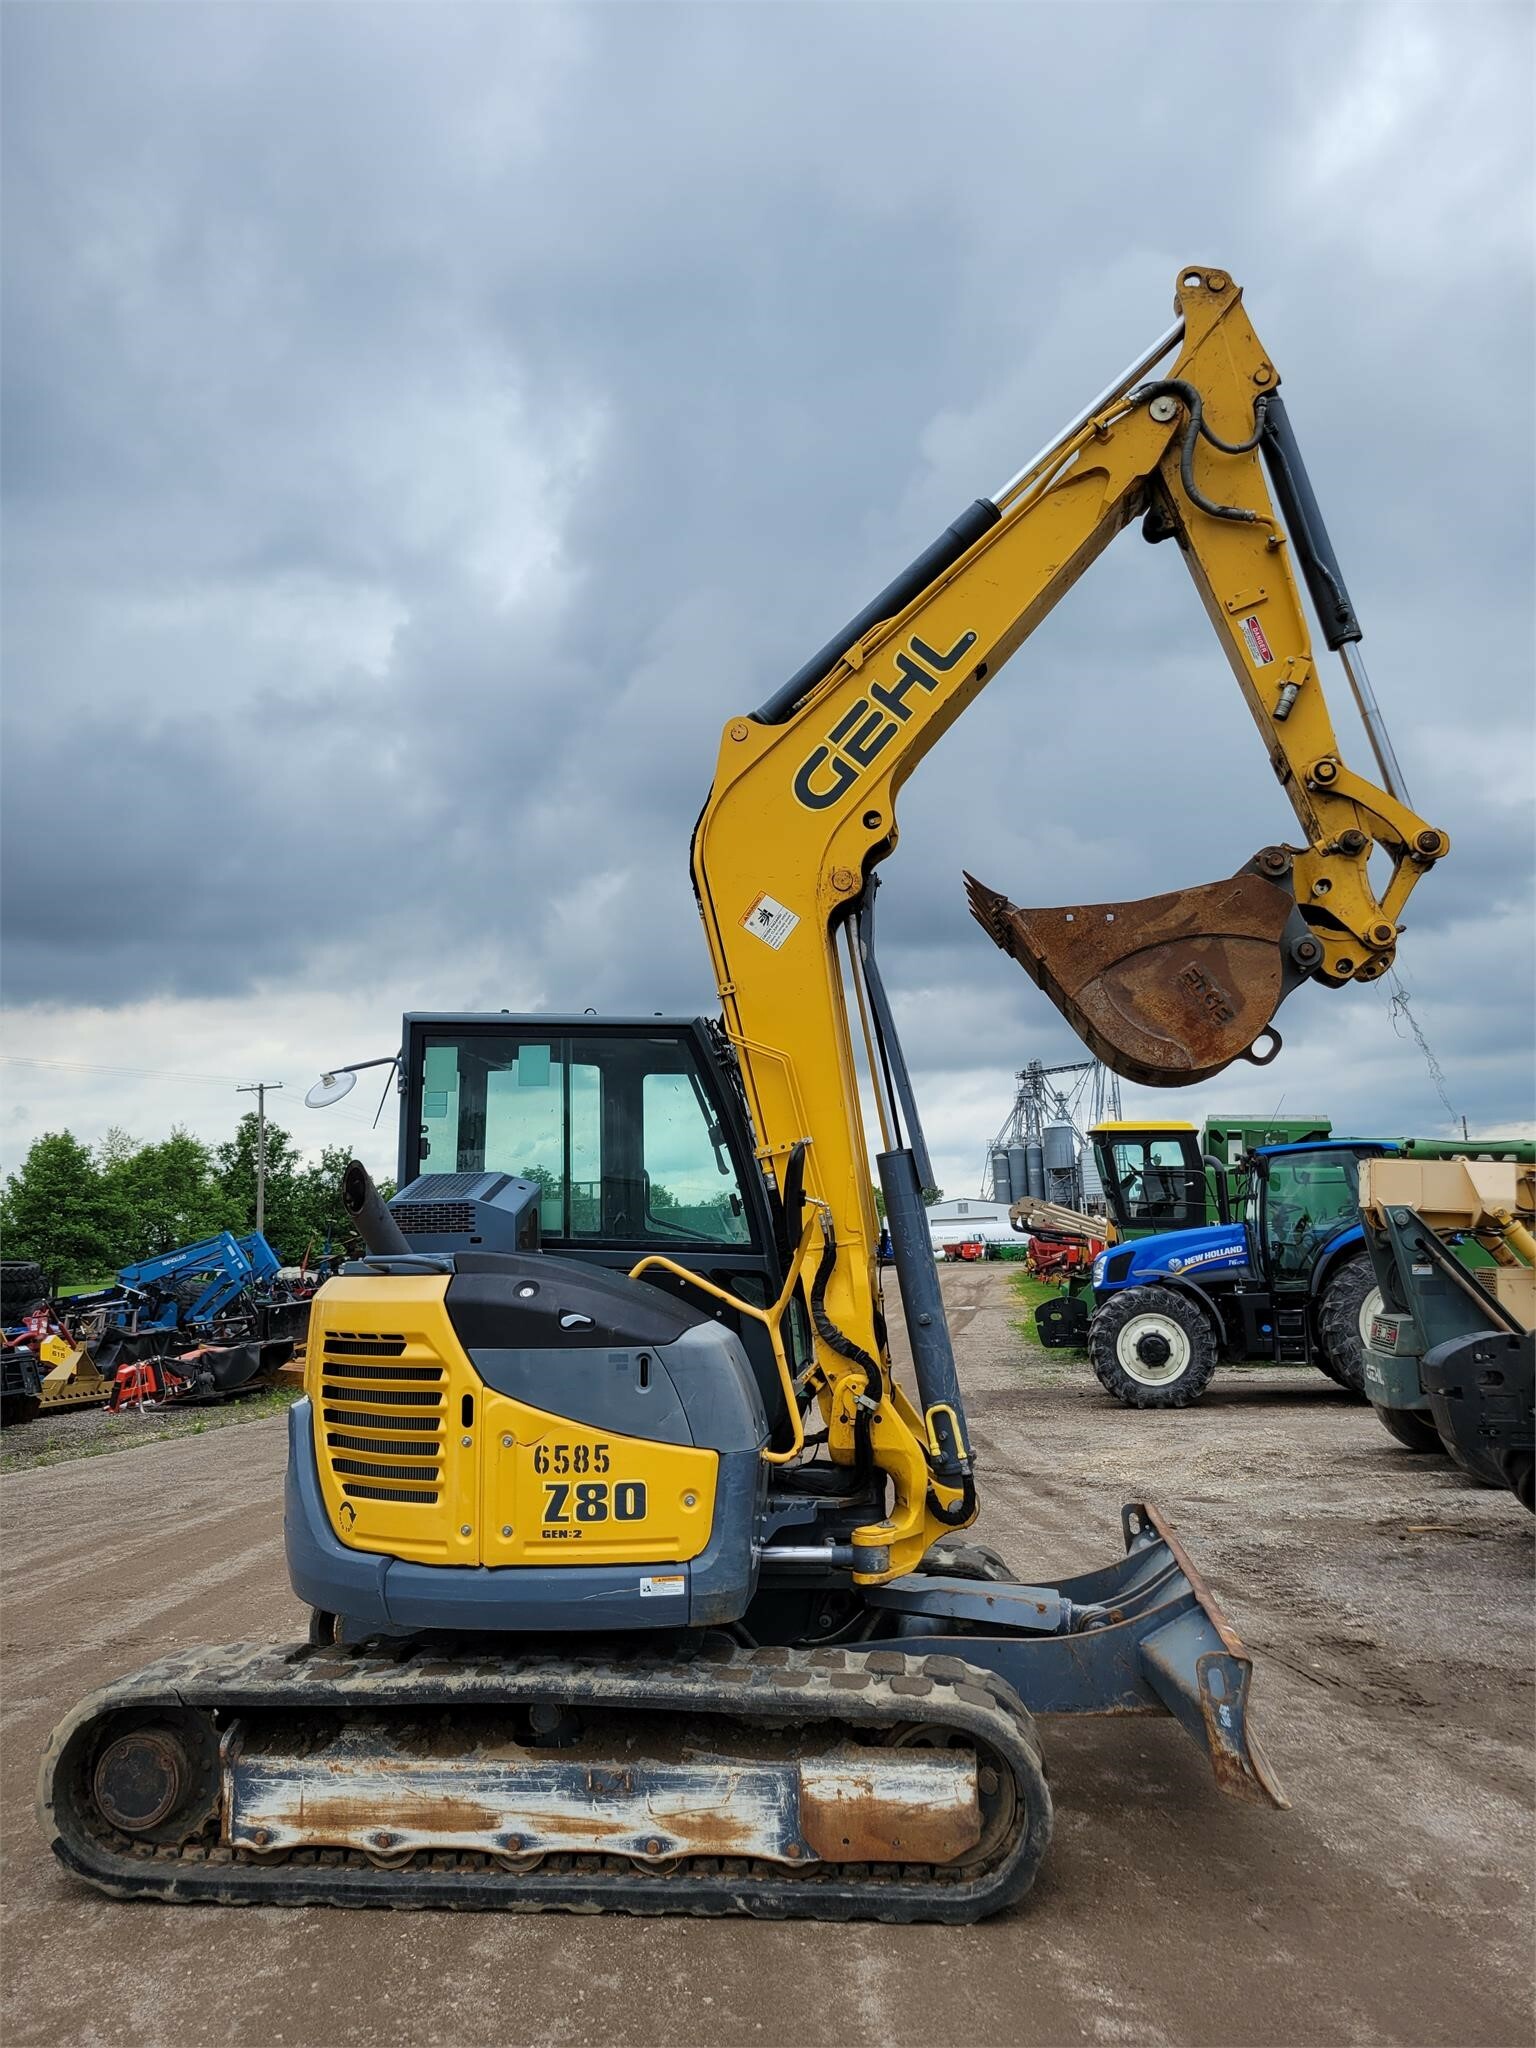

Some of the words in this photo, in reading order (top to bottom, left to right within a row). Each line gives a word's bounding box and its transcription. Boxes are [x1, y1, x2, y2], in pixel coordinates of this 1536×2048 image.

[1253, 627, 1267, 653] DANGER
[793, 629, 978, 811] GEHL
[1184, 1255, 1204, 1265] NEW
[1204, 1246, 1243, 1259] HOLLAND
[534, 1444, 610, 1474] 6585
[542, 1480, 648, 1524] Z80
[542, 1529, 583, 1539] GEN:2
